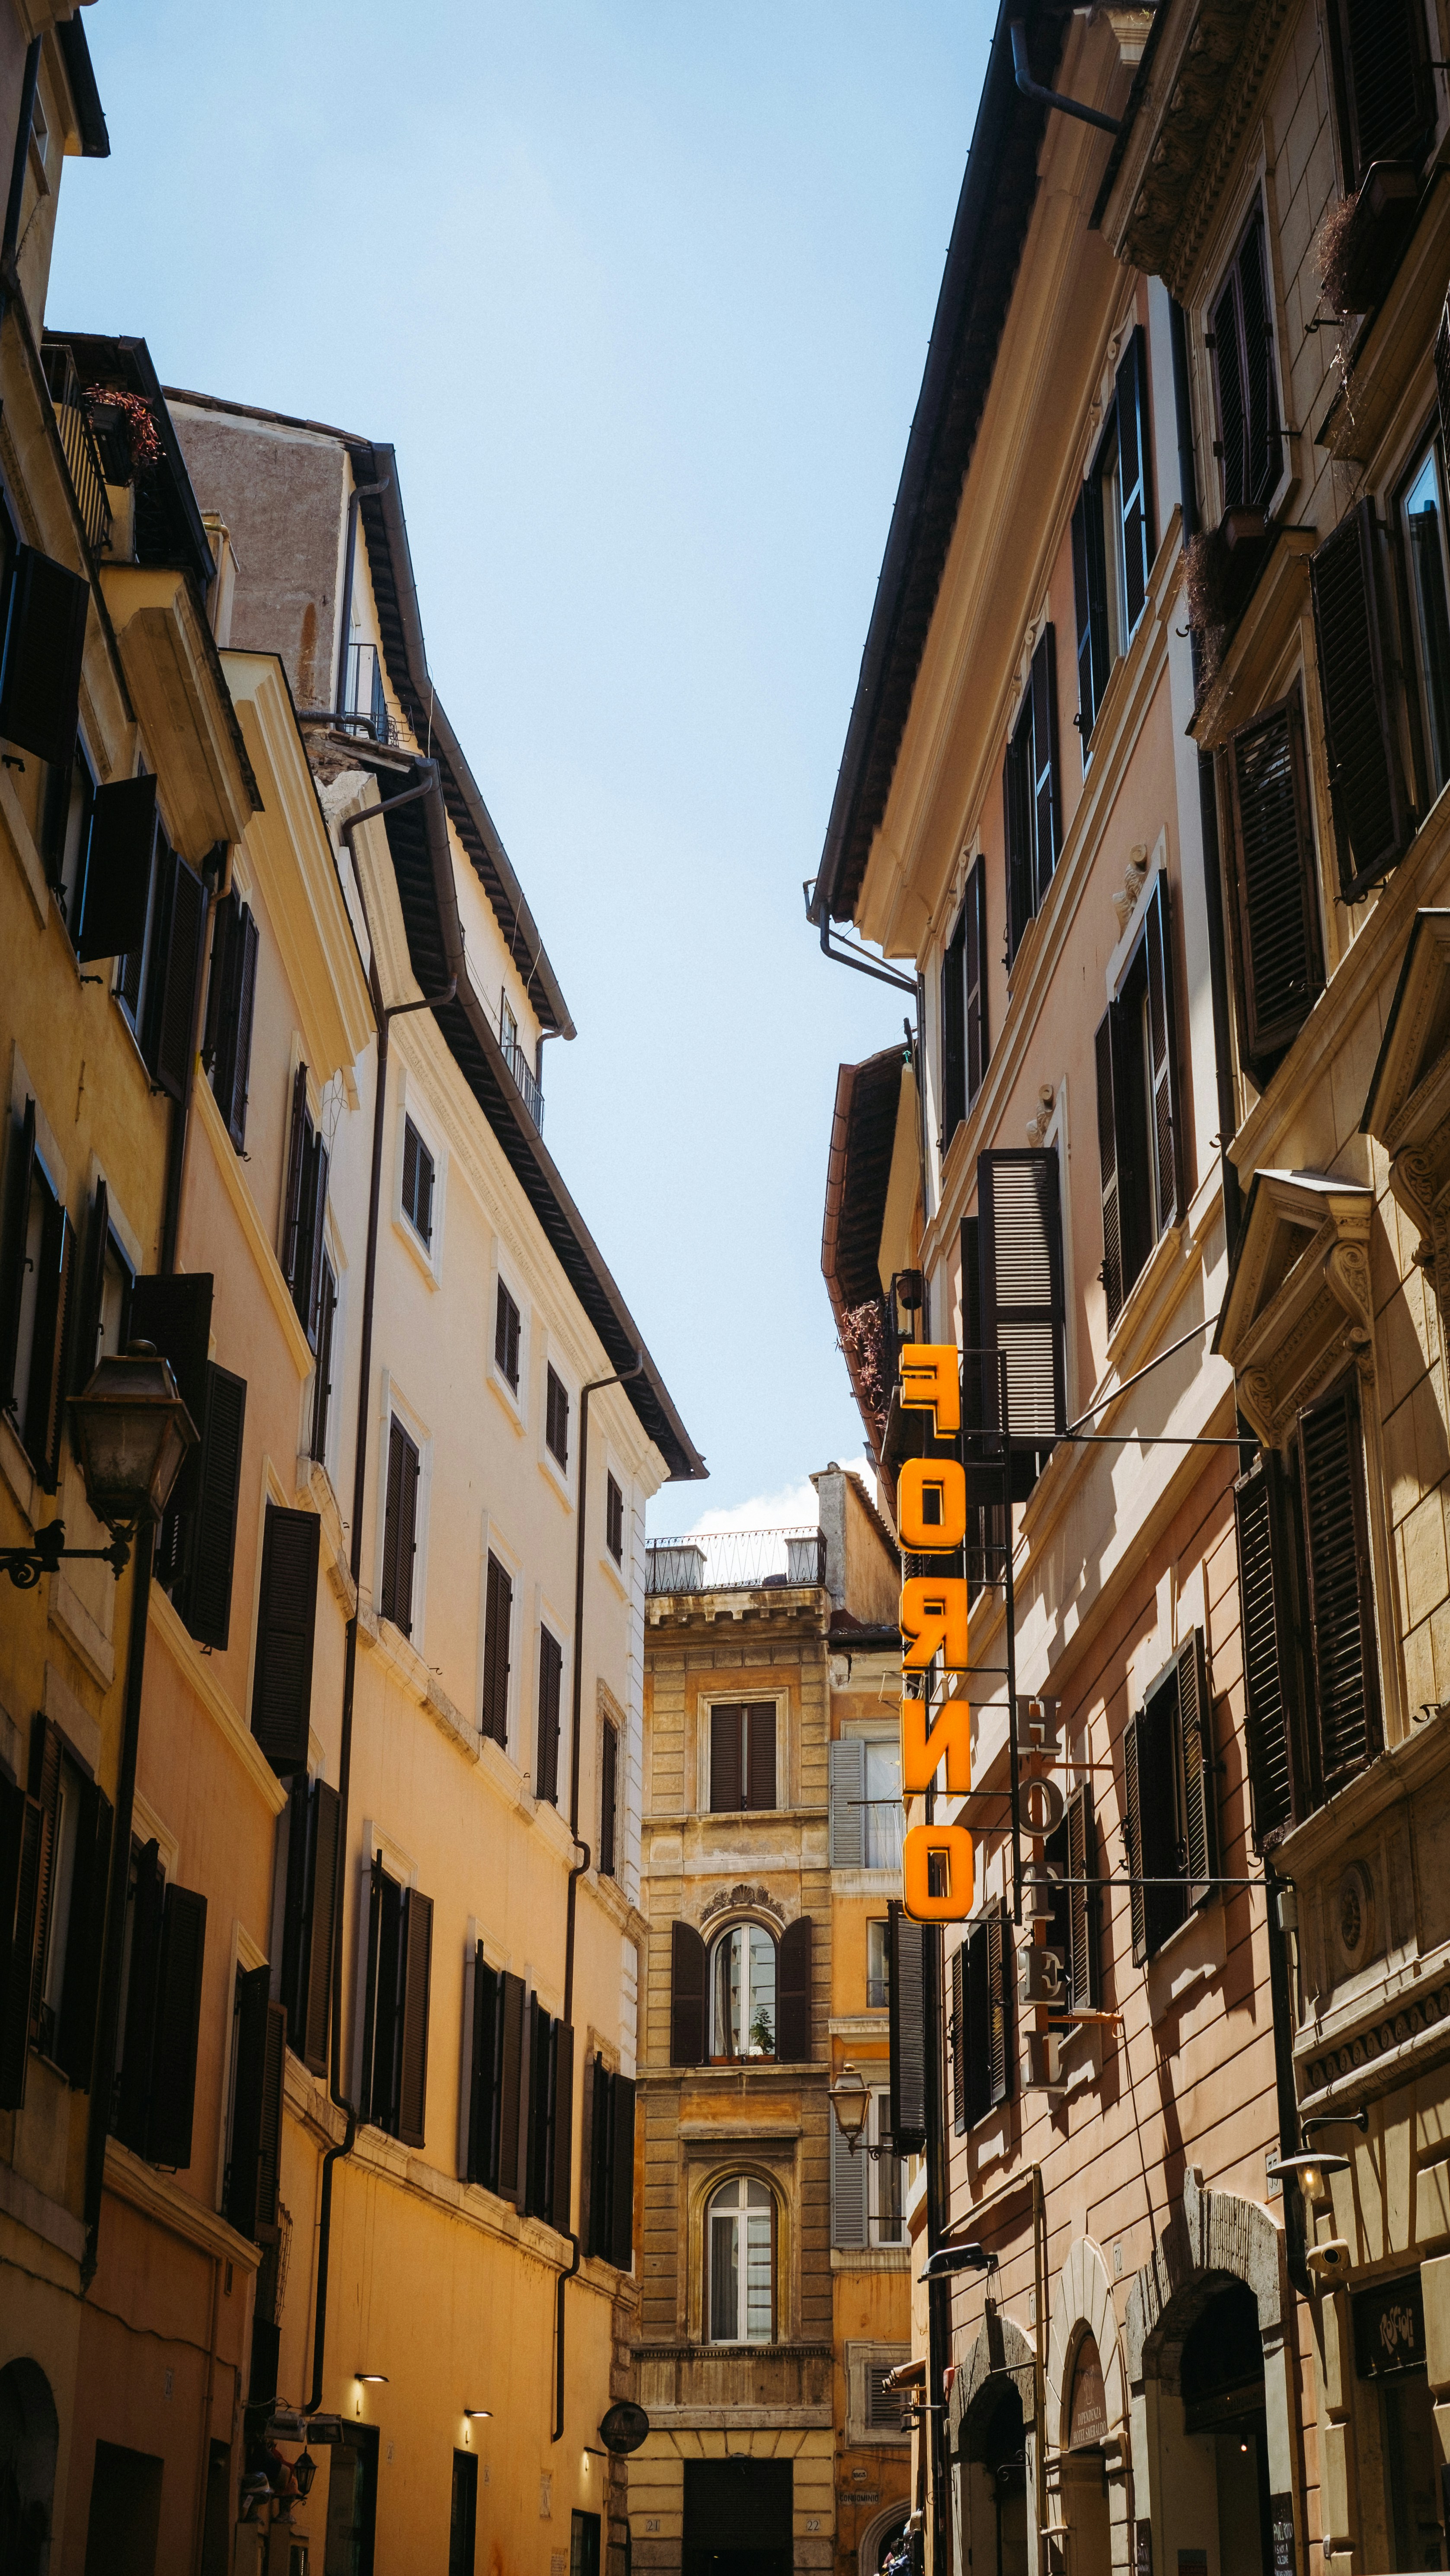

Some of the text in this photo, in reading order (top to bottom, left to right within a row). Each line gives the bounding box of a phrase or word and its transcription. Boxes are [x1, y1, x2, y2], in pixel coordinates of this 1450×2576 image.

[1016, 1694, 1069, 2093] HOTEL
[1114, 2249, 1122, 2273] 32
[1077, 2406, 1102, 2426] DIPENDENZA
[1073, 2421, 1106, 2444] HOTEL SMERALDO
[839, 2493, 879, 2501] CONDOMINIO
[647, 2521, 658, 2531] 21
[807, 2520, 820, 2531] 22
